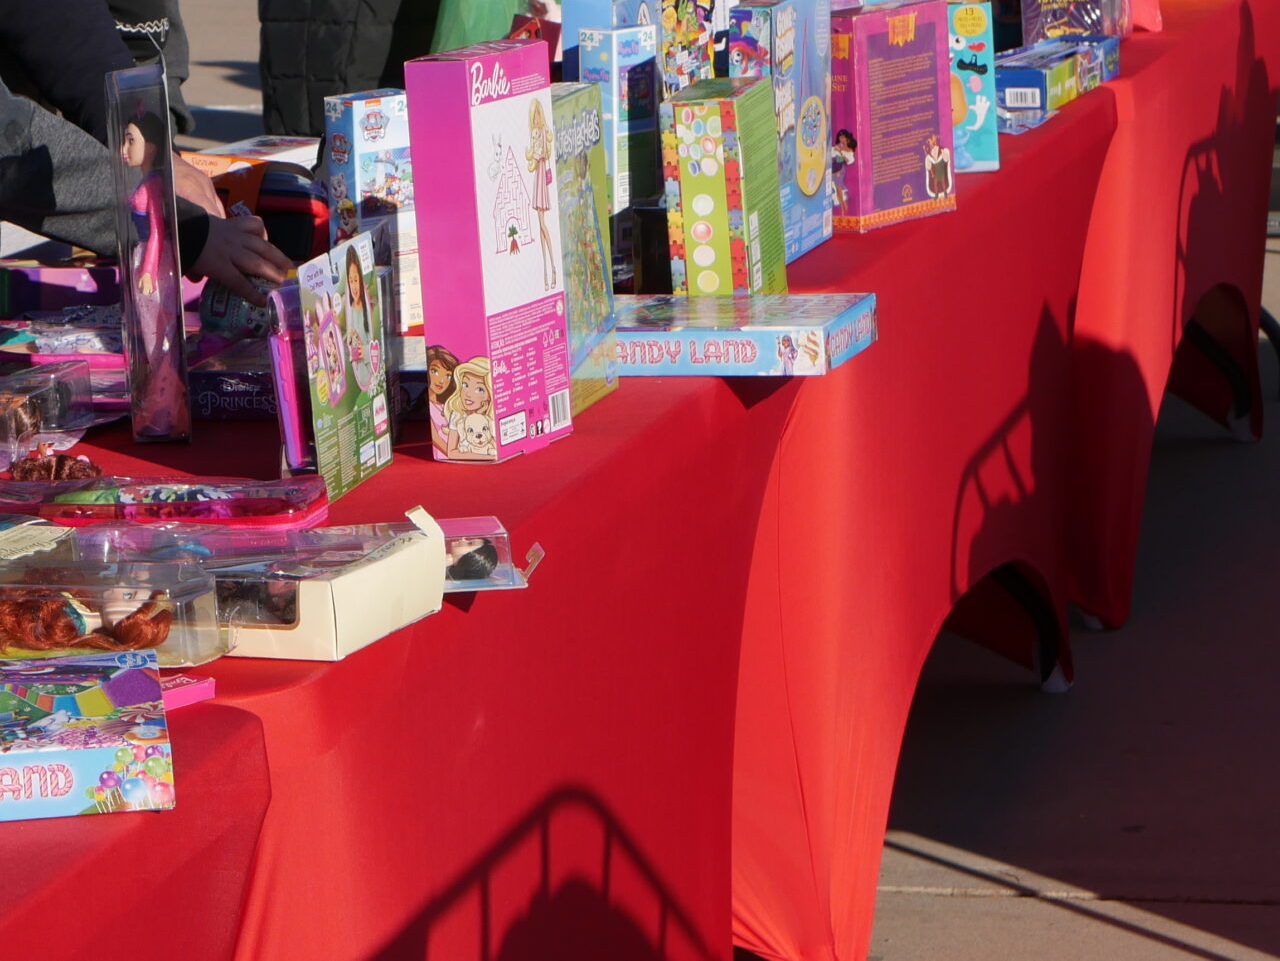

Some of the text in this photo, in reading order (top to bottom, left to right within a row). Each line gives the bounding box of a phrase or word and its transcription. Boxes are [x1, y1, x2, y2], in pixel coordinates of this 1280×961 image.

[471, 62, 510, 106] Barbie
[326, 102, 338, 114] 24
[616, 340, 757, 365] ANDY LAND
